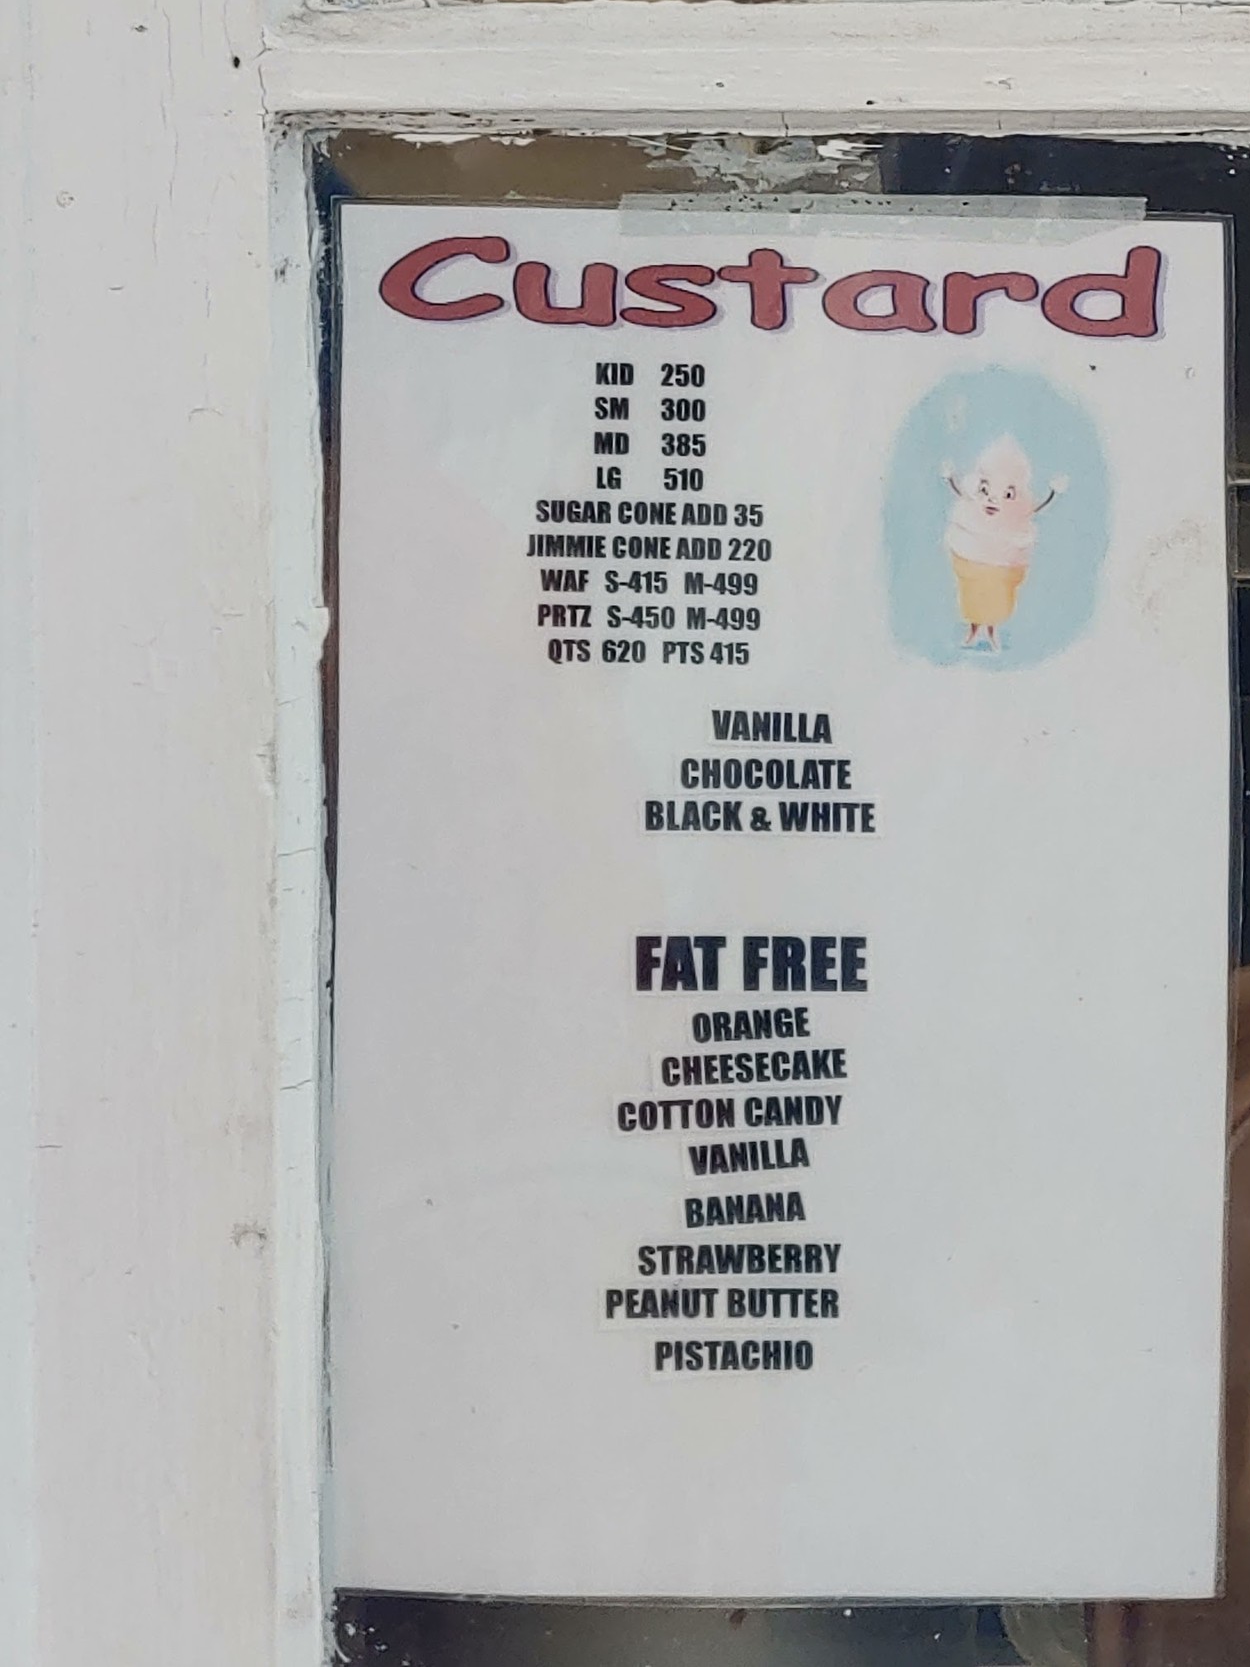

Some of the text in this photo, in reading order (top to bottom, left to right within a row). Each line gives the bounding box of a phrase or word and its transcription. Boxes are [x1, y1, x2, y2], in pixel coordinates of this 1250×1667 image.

[378, 236, 1162, 338] Custard
[595, 397, 705, 422] SM 300
[597, 467, 703, 491] LG 510
[527, 534, 771, 561] JIMMIE CONE ADD 220
[538, 604, 760, 631] PRTZ S-450 M-499
[712, 710, 832, 744] VANILLA
[646, 801, 875, 833] BLACK & WHITE
[636, 936, 867, 992] FAT FREE
[688, 1138, 810, 1175] VANILLA
[638, 1244, 841, 1276] STRAWBERRY
[655, 1340, 813, 1371] PISTACHIO
